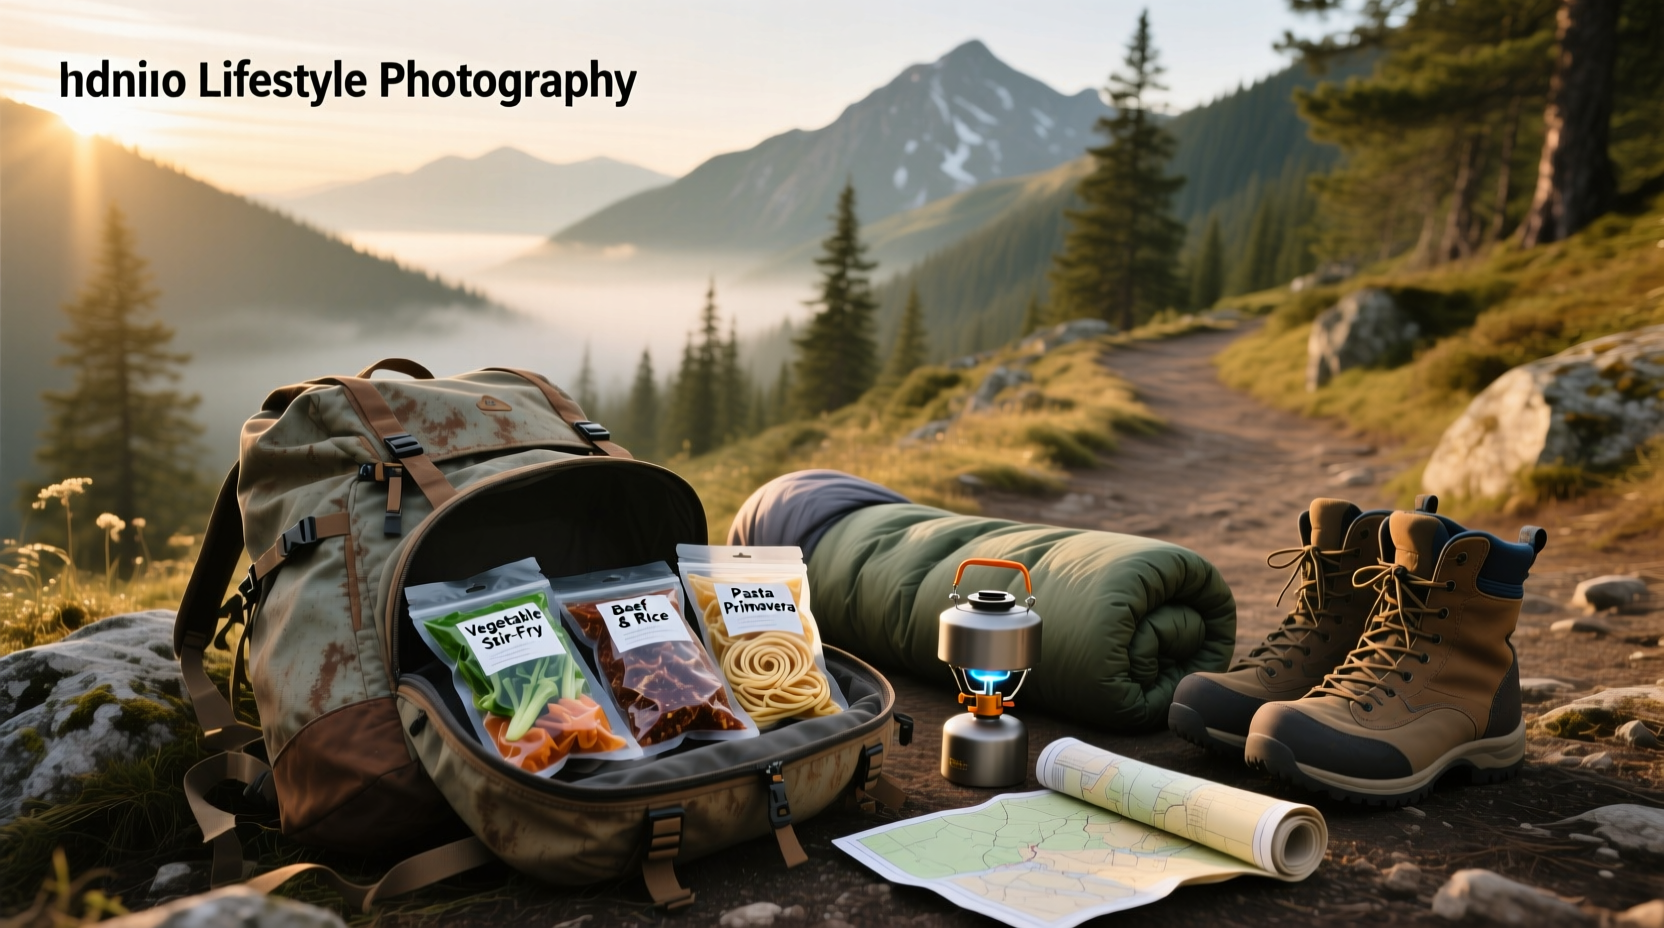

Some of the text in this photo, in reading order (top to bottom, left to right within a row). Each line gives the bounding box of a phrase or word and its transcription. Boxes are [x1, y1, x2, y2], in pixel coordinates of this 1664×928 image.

[731, 587, 775, 599] Pasta
[465, 608, 542, 636] Vegetable
[619, 616, 631, 628] &
